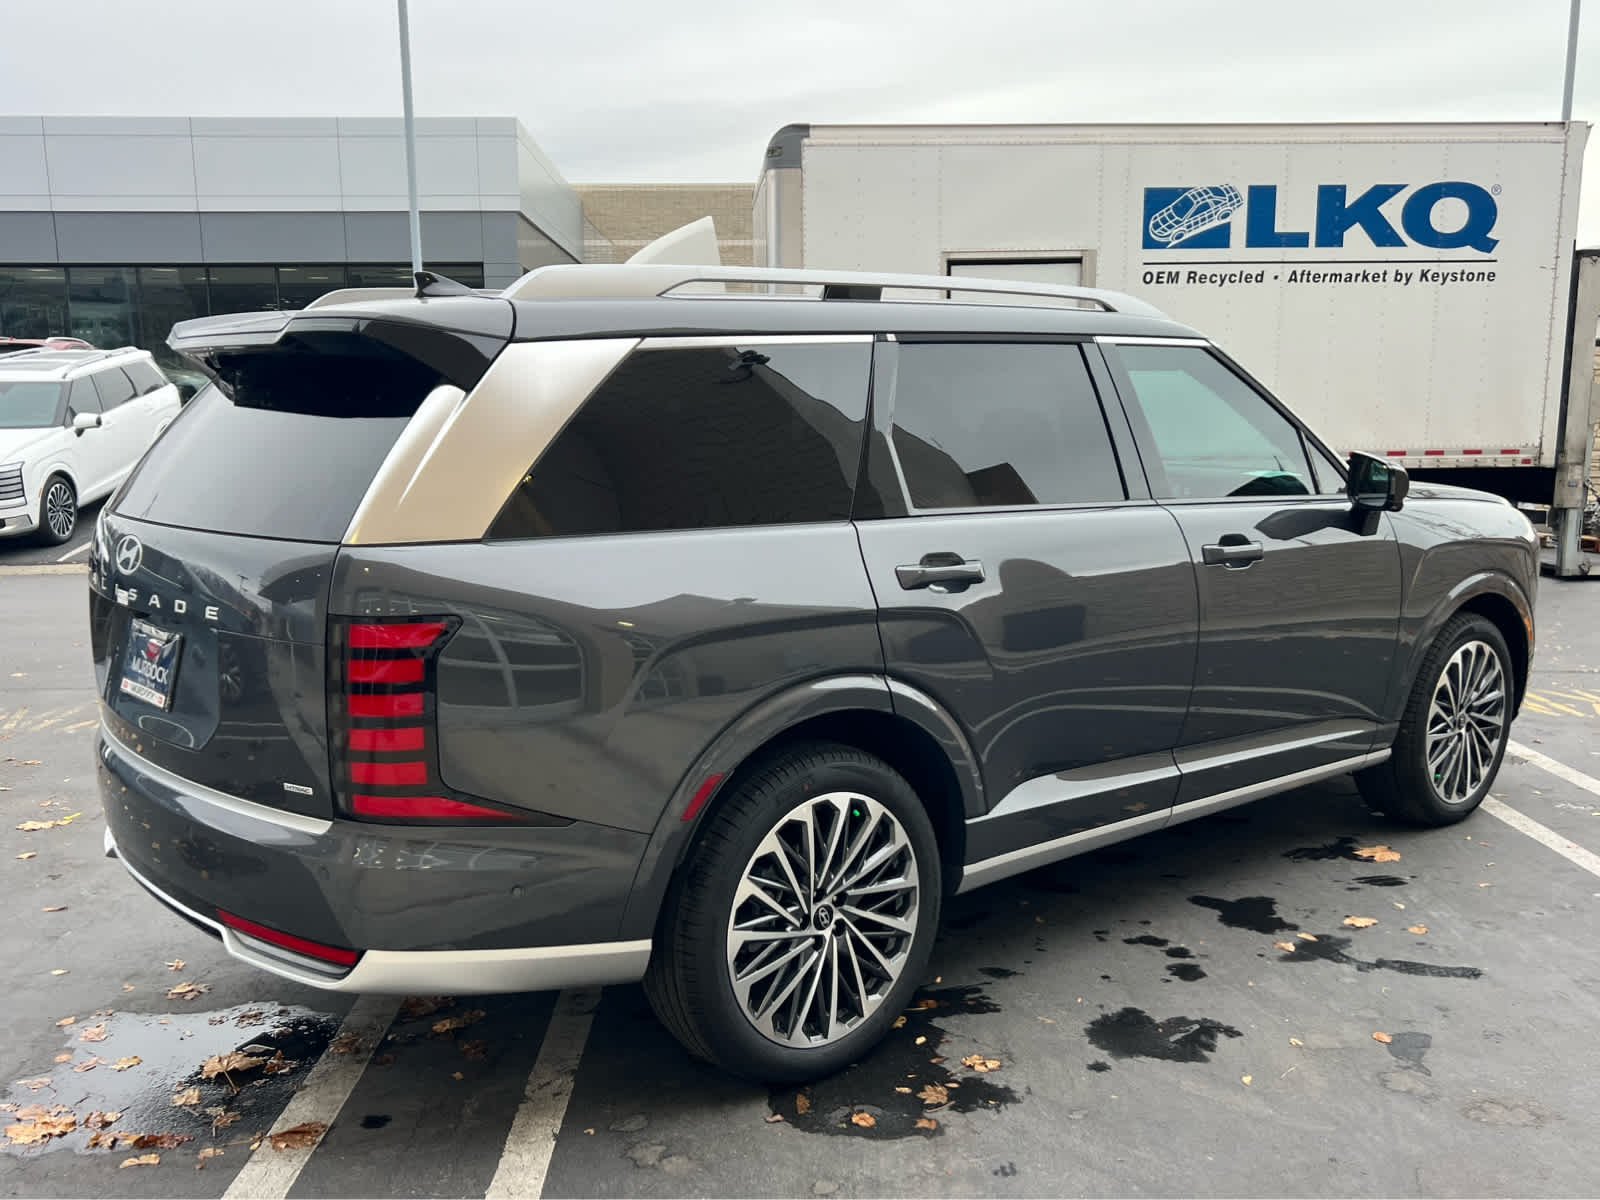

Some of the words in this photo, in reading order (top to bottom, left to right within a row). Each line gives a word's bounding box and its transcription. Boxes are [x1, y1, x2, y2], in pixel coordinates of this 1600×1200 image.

[1245, 181, 1500, 254] LKQ
[1142, 271, 1180, 284] OEM
[1186, 270, 1265, 287] Recycled
[1287, 269, 1388, 284] Aftermarket
[1393, 270, 1414, 286] by
[1419, 269, 1497, 286] Keystone
